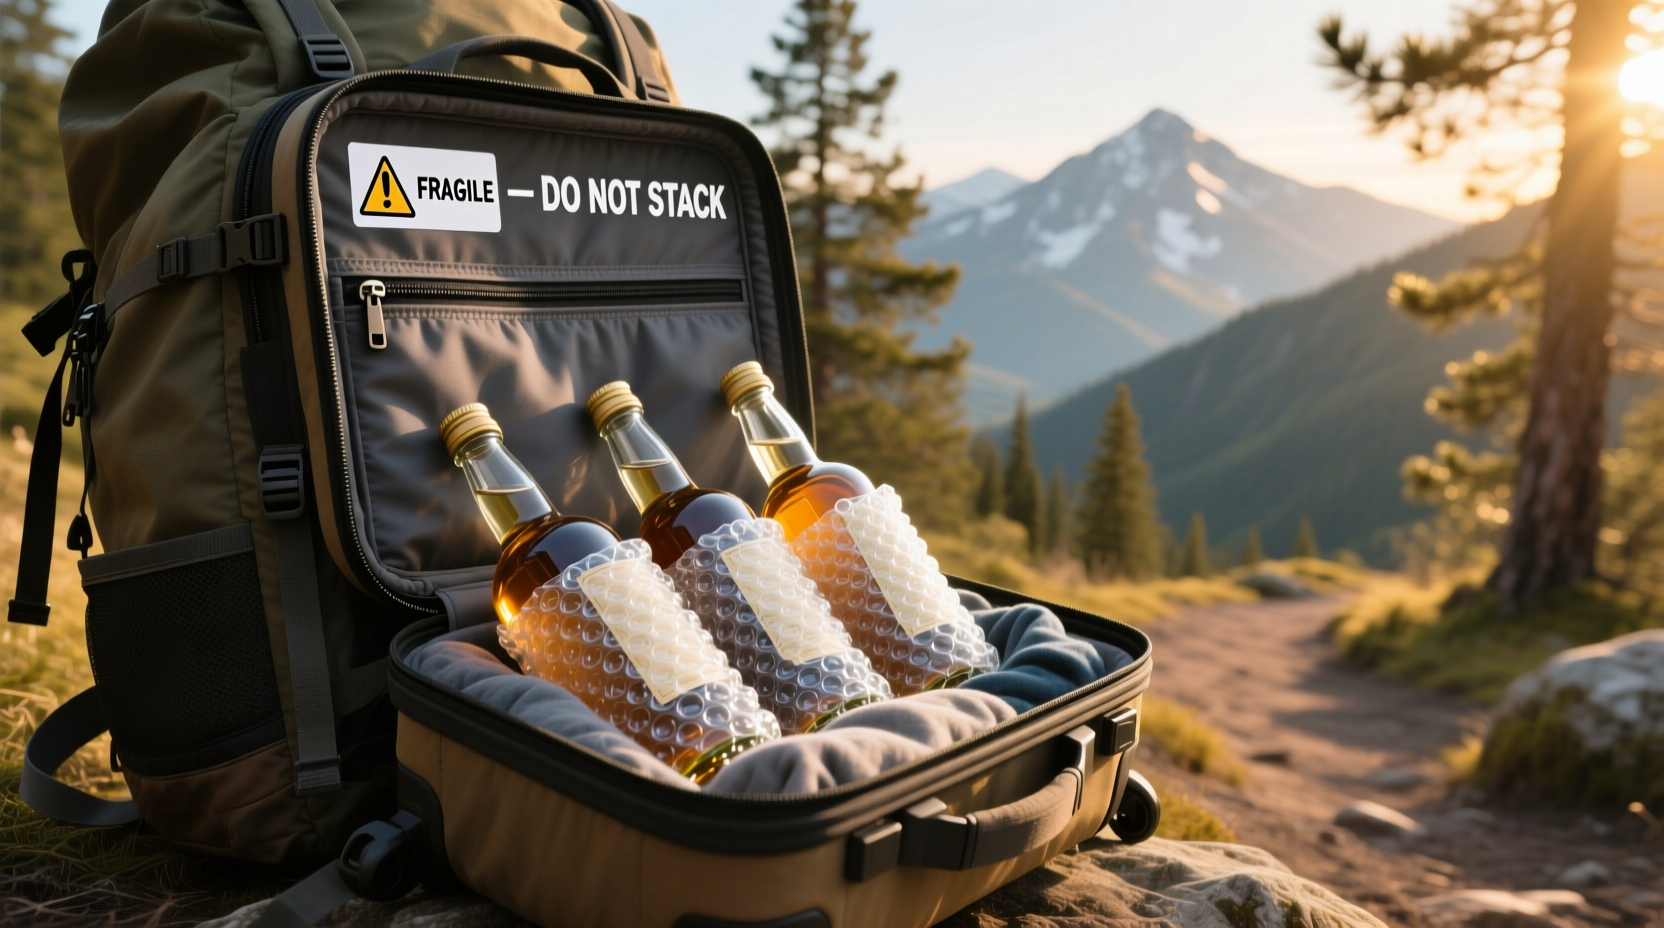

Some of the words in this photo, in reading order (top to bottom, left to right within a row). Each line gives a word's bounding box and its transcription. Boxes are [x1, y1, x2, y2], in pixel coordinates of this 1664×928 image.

[417, 176, 494, 203] FRAGILE
[540, 175, 581, 213] DO
[588, 178, 641, 215] NOT
[647, 181, 727, 219] STACK
